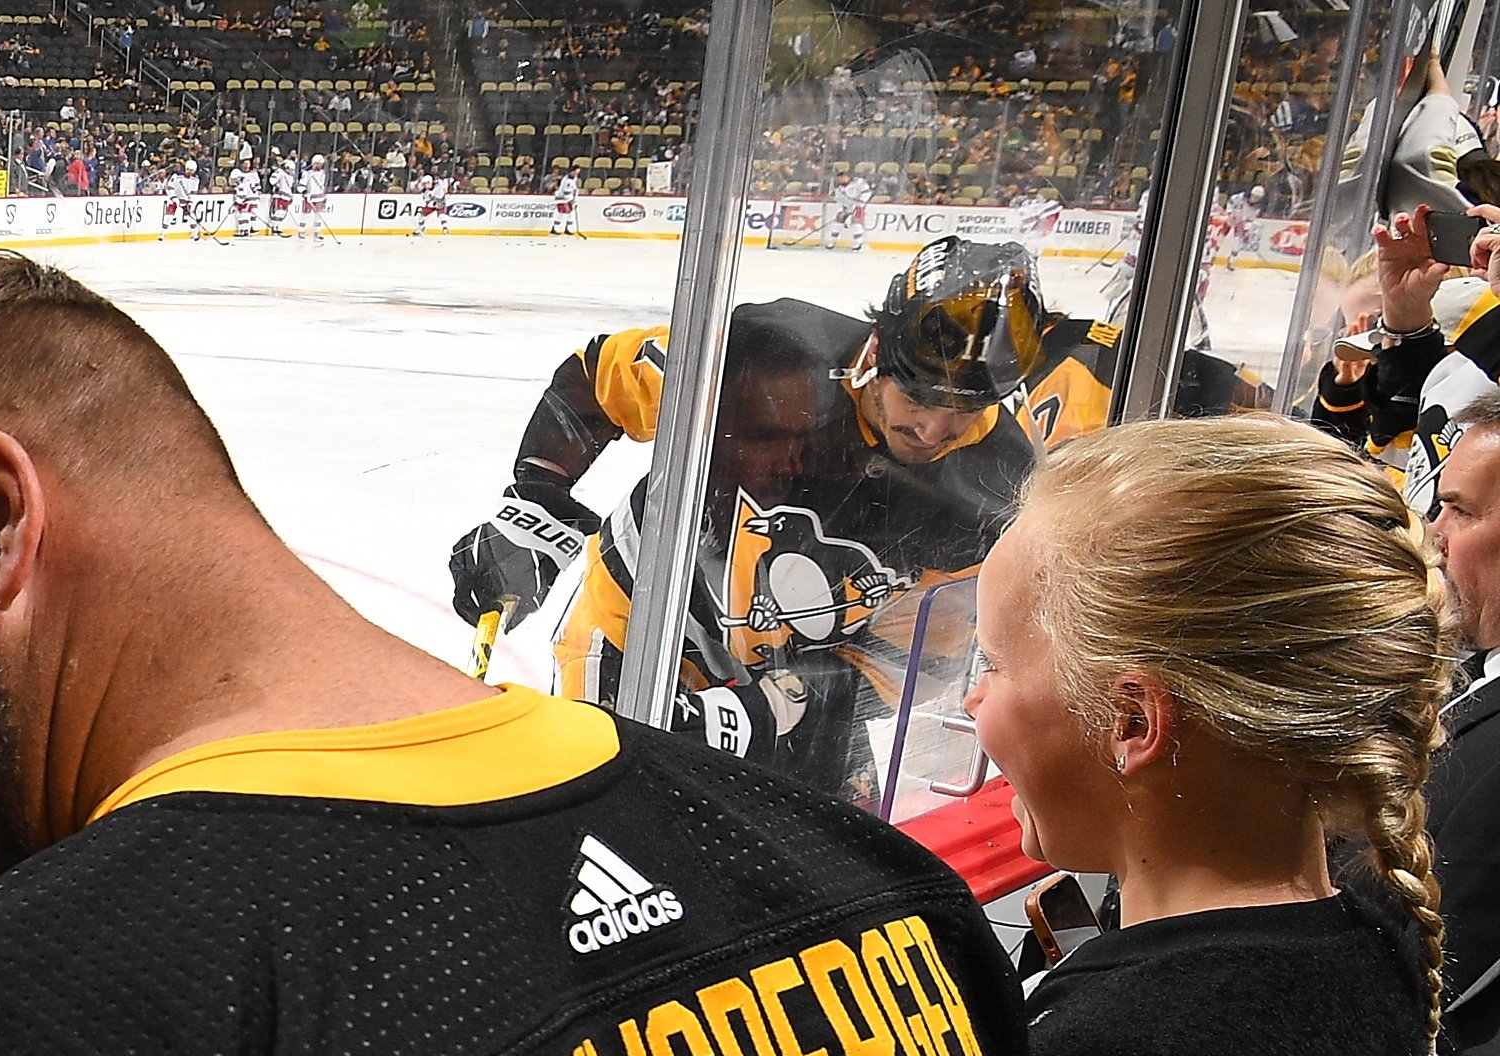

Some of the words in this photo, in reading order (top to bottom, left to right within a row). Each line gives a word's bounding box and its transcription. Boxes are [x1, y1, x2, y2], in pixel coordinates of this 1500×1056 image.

[84, 199, 143, 229] Sheely's
[449, 203, 480, 217] Ford
[496, 202, 556, 211] NEIGHBORHO
[602, 206, 646, 219] Glidden
[653, 207, 664, 218] by
[522, 211, 554, 219] STORE
[957, 215, 1006, 224] SPORTS
[863, 213, 945, 234] UPMC
[1056, 220, 1111, 236] LUMBER
[961, 334, 991, 361] 11
[1032, 394, 1064, 442] 7
[568, 886, 685, 954] adidas
